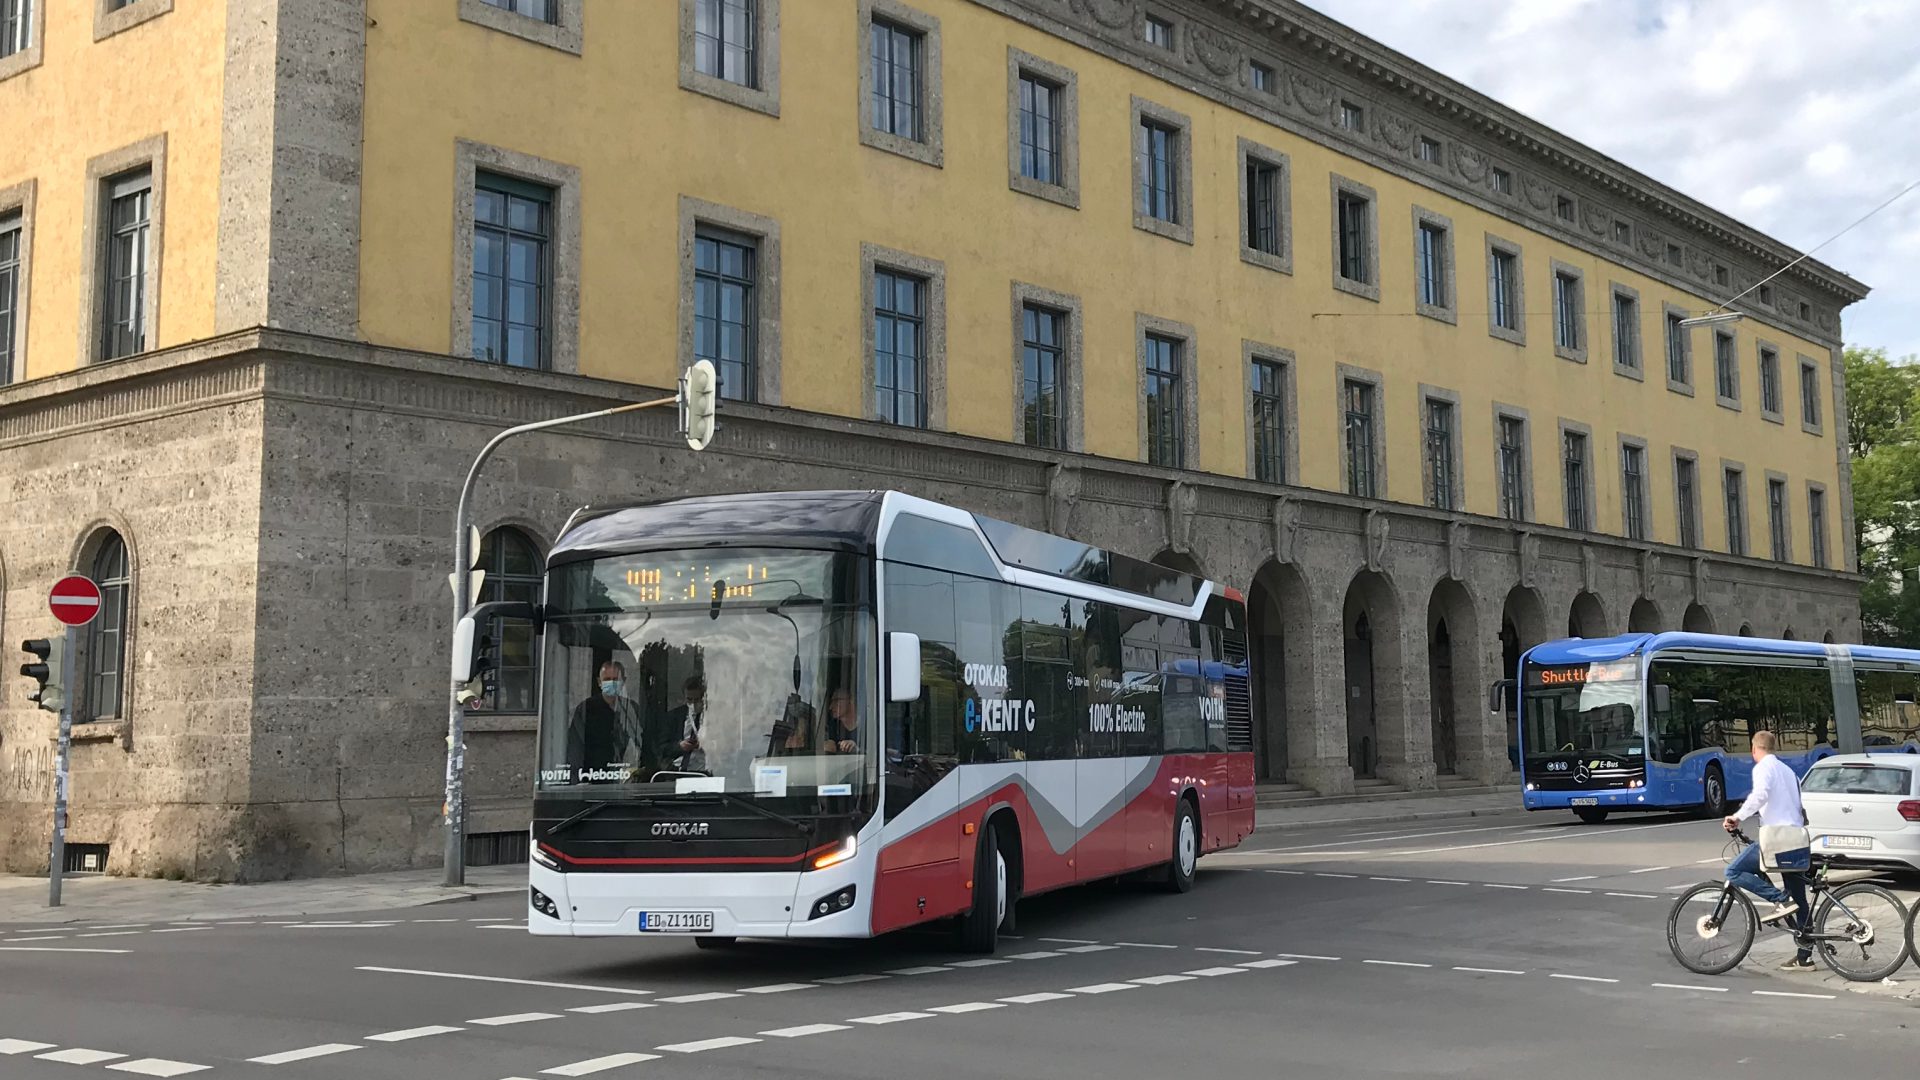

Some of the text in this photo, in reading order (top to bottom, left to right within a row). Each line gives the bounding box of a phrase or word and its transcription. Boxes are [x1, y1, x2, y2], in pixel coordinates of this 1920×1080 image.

[964, 663, 1008, 687] OTOKAR
[965, 698, 1036, 733] e-KENT C
[1088, 703, 1146, 732] 100% Electric
[1198, 696, 1224, 721] VOITH
[1600, 760, 1619, 768] E-Bus
[541, 769, 571, 781] VOITH
[578, 767, 631, 782] Webasto
[651, 823, 709, 836] OTOKAR
